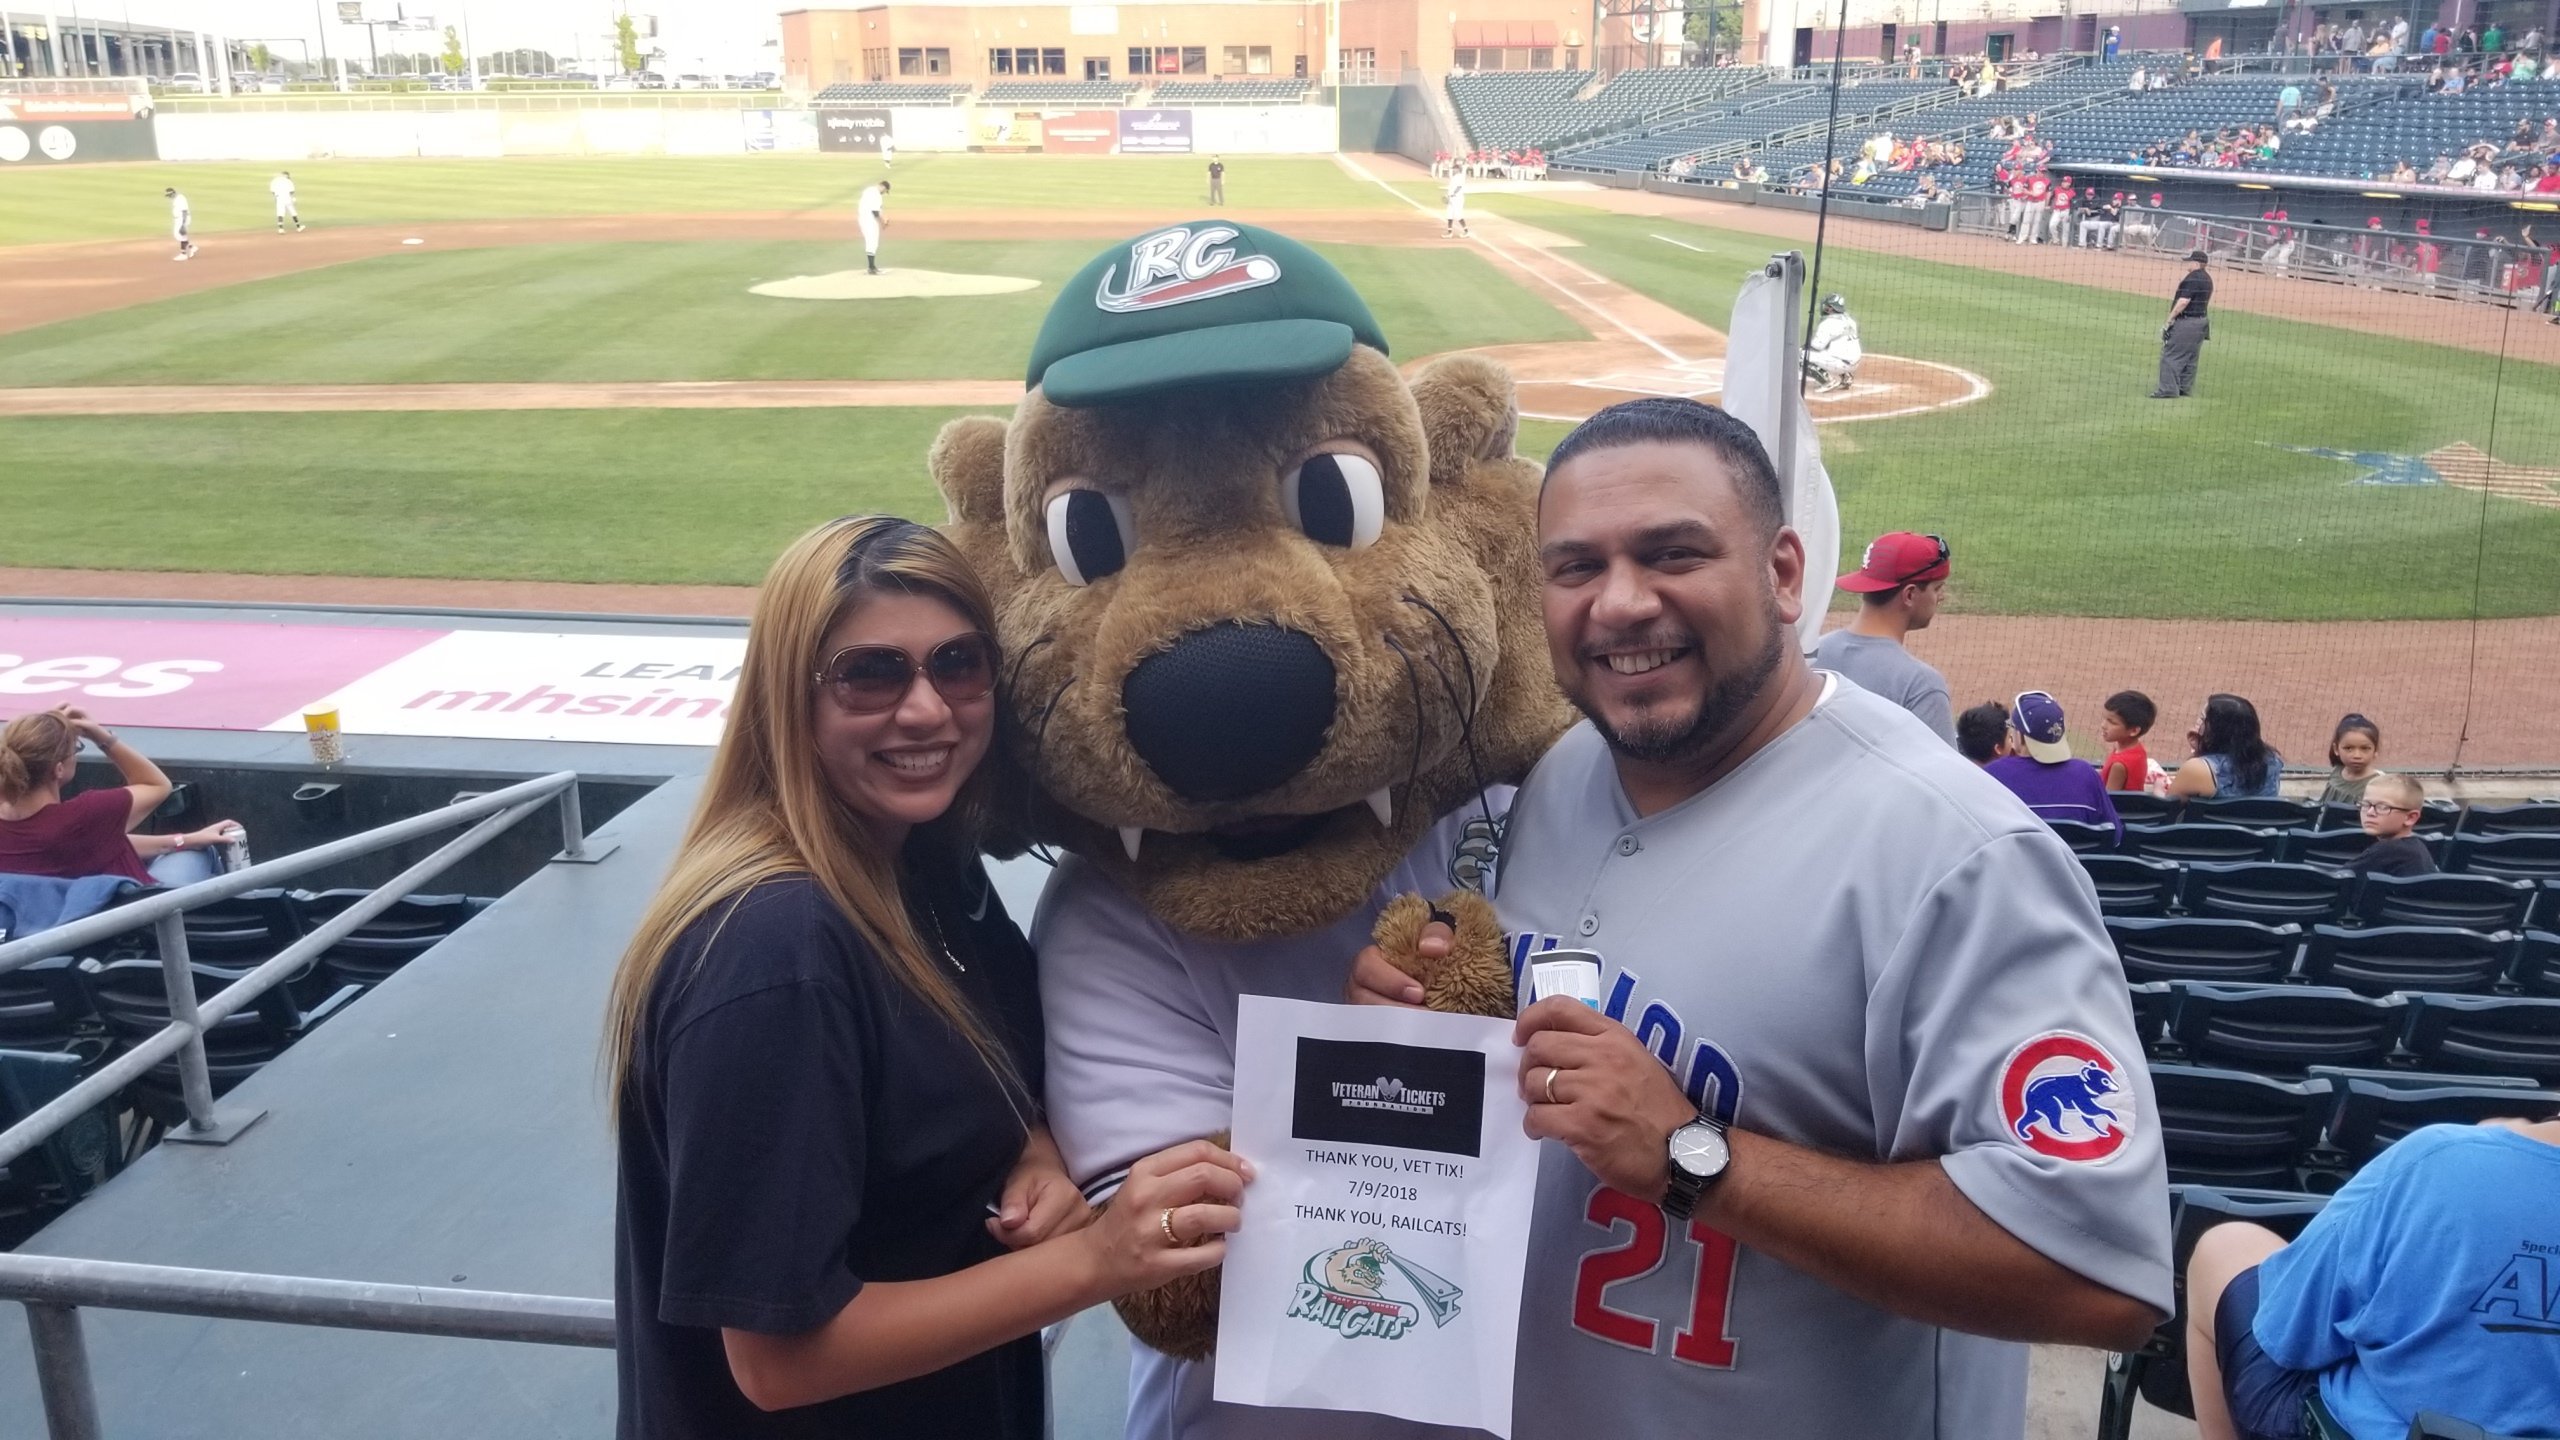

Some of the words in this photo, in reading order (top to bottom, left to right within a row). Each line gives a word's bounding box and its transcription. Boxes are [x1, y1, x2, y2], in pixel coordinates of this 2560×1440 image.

[1127, 226, 1240, 294] RC
[0, 654, 224, 697] es
[1332, 1082, 1379, 1099] VETERAN
[1400, 1087, 1446, 1107] TICKETS
[1348, 1100, 1427, 1113] FOUNDATION
[1306, 1150, 1358, 1166] THANK
[1362, 1154, 1398, 1173] YOU,
[1403, 1159, 1431, 1174] VET
[1435, 1162, 1464, 1179] TIX!
[1348, 1180, 1418, 1201] 7/9/2018
[1294, 1204, 1346, 1222] THANK
[1350, 1210, 1386, 1229] YOU,
[1391, 1214, 1467, 1237] RAILCATS!
[2521, 1240, 2560, 1255] Speci
[1571, 1183, 1741, 1370] 21
[2469, 1253, 2560, 1325] A
